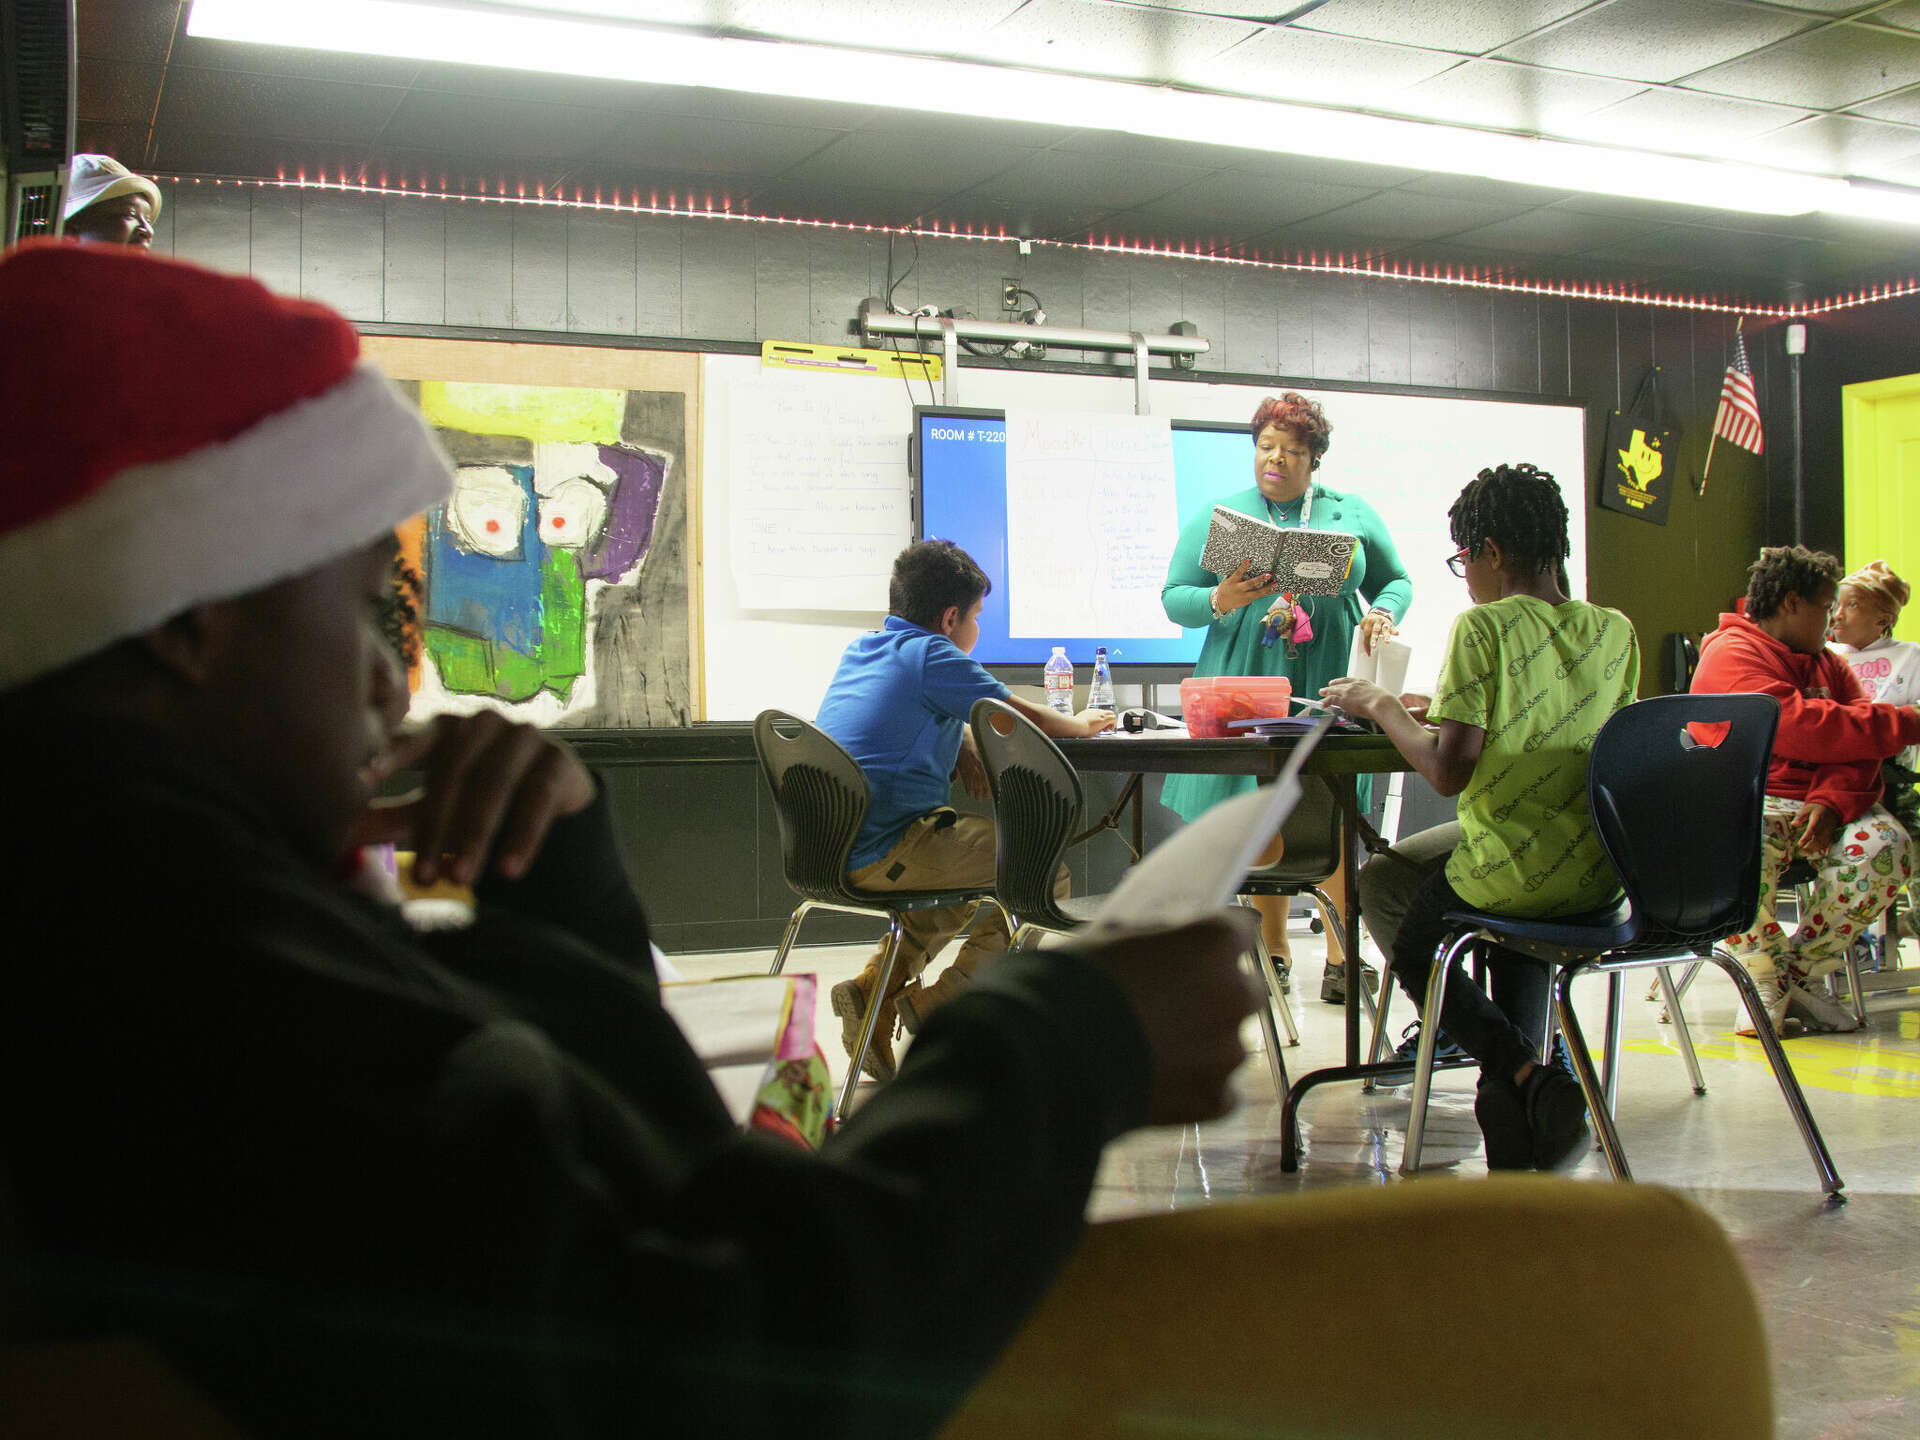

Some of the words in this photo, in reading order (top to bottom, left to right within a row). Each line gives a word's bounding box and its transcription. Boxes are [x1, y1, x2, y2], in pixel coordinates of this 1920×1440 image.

[931, 428, 965, 441] ROOM
[968, 430, 975, 441] #
[977, 430, 1006, 443] T-220
[1523, 690, 1598, 753] Champion
[1493, 764, 1562, 825] Champion
[1523, 823, 1592, 893] Champion
